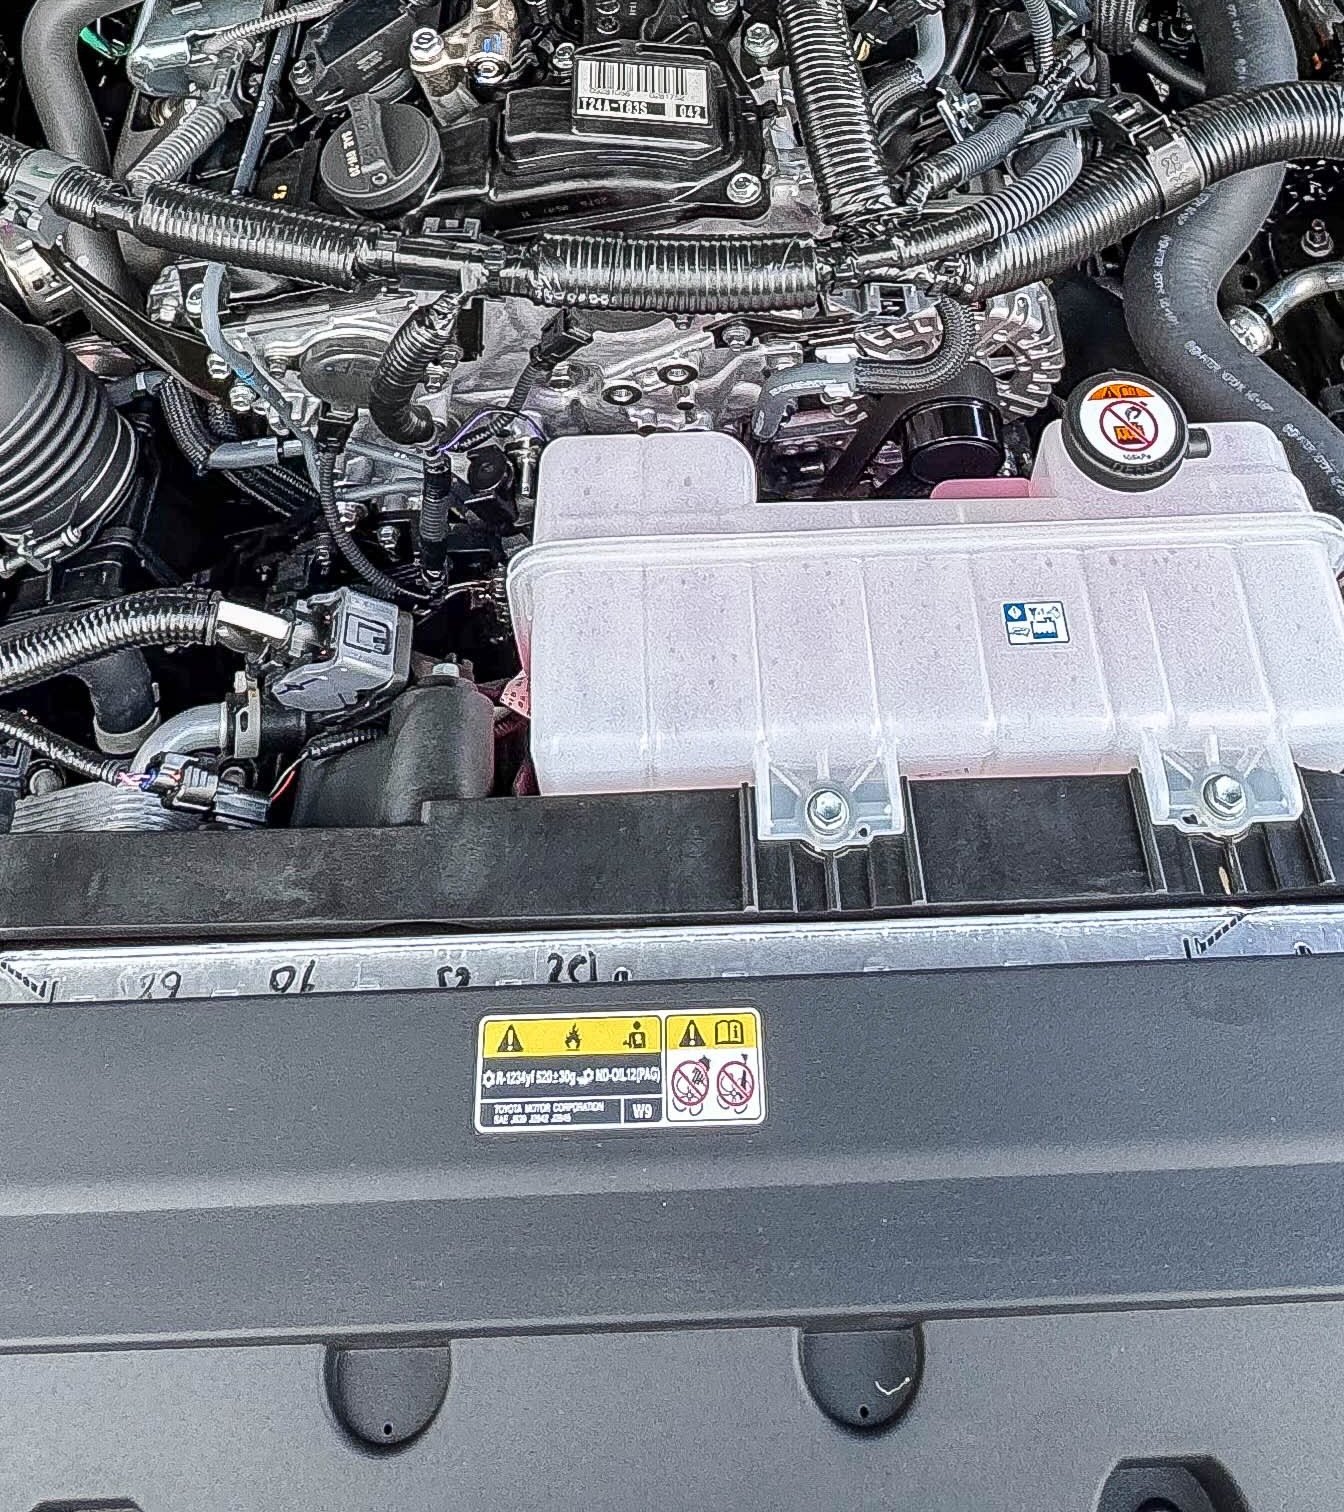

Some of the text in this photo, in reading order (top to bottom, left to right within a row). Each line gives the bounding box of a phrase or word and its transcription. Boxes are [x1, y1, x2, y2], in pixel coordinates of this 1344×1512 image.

[679, 105, 702, 119] 042
[495, 1069, 536, 1088] R-1234yf
[494, 1101, 605, 1114] TOYOTA MOTOR CORPORATION
[632, 1103, 653, 1119] W9
